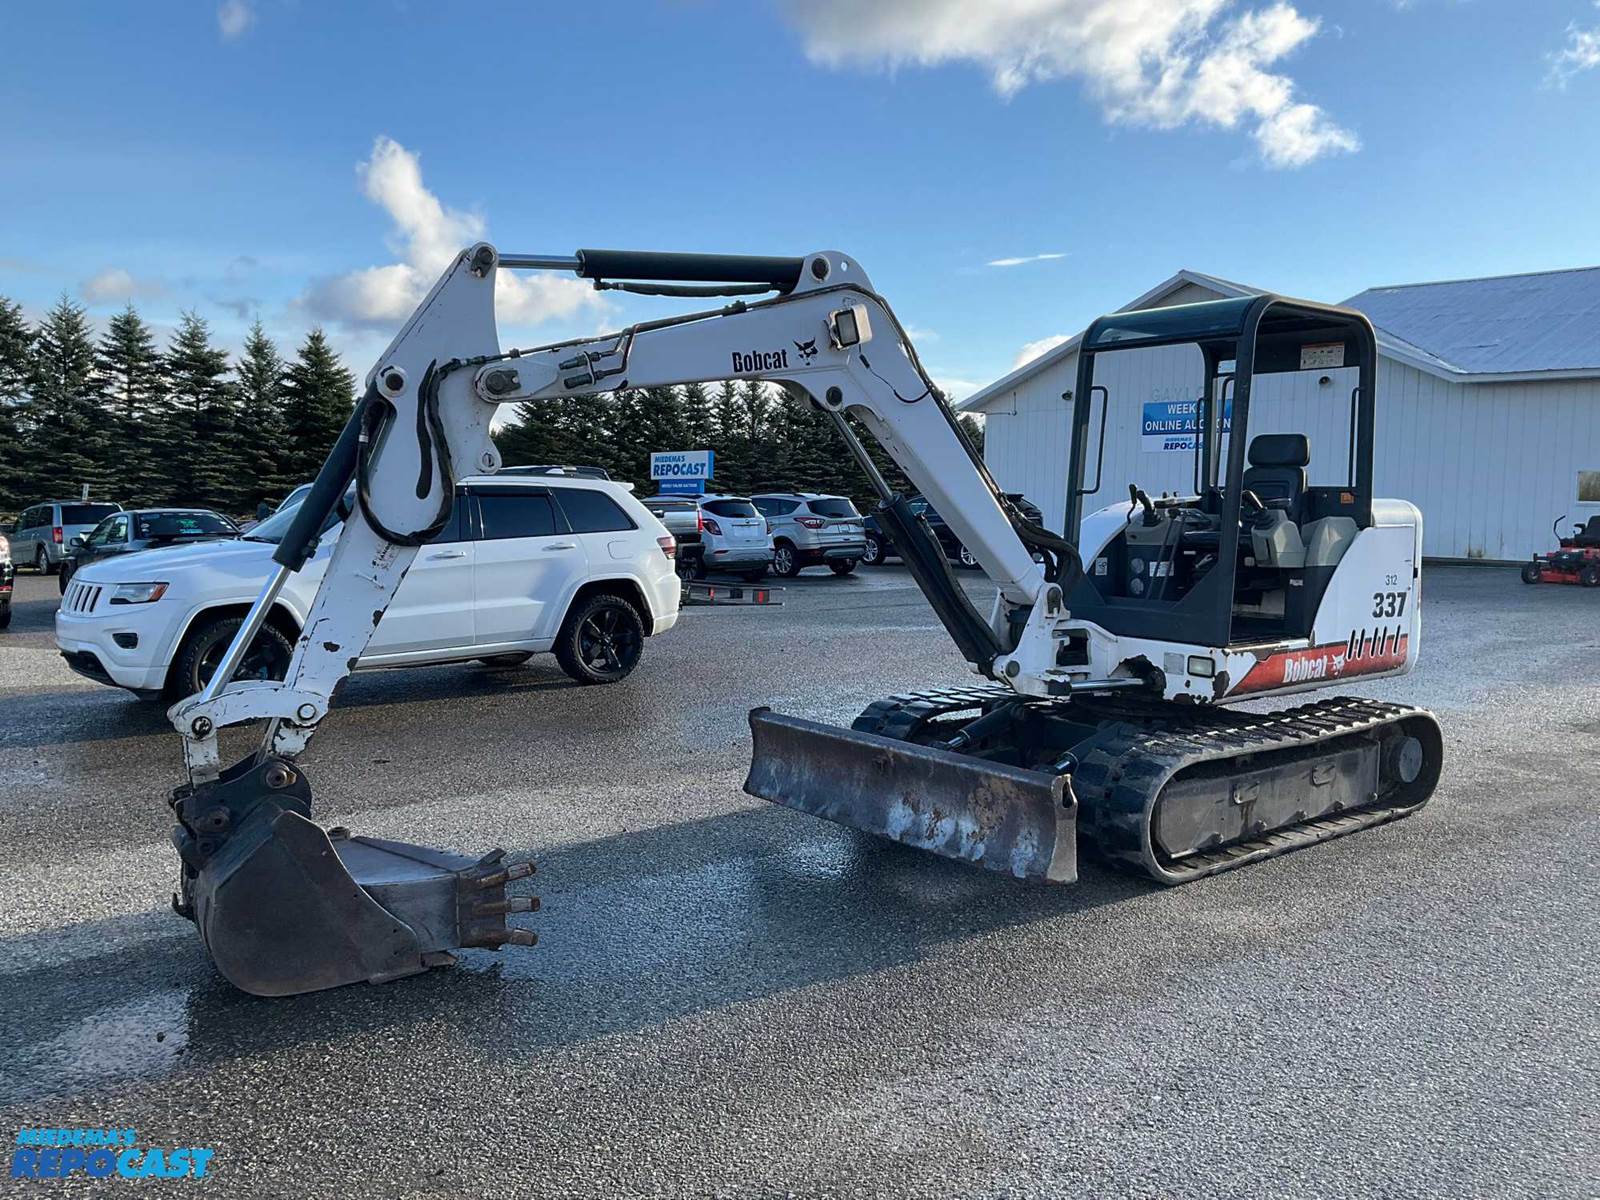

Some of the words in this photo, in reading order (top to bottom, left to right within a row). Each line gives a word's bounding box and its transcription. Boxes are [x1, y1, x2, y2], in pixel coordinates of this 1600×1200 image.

[731, 349, 789, 373] Bobcat
[1167, 402, 1204, 414] WEEK
[1145, 420, 1182, 432] ONLINE
[1163, 442, 1205, 451] REPOCAS
[653, 462, 706, 476] REPOCAST
[1385, 574, 1398, 586] 312
[1372, 592, 1407, 618] 337
[1282, 655, 1328, 683] Bobcat
